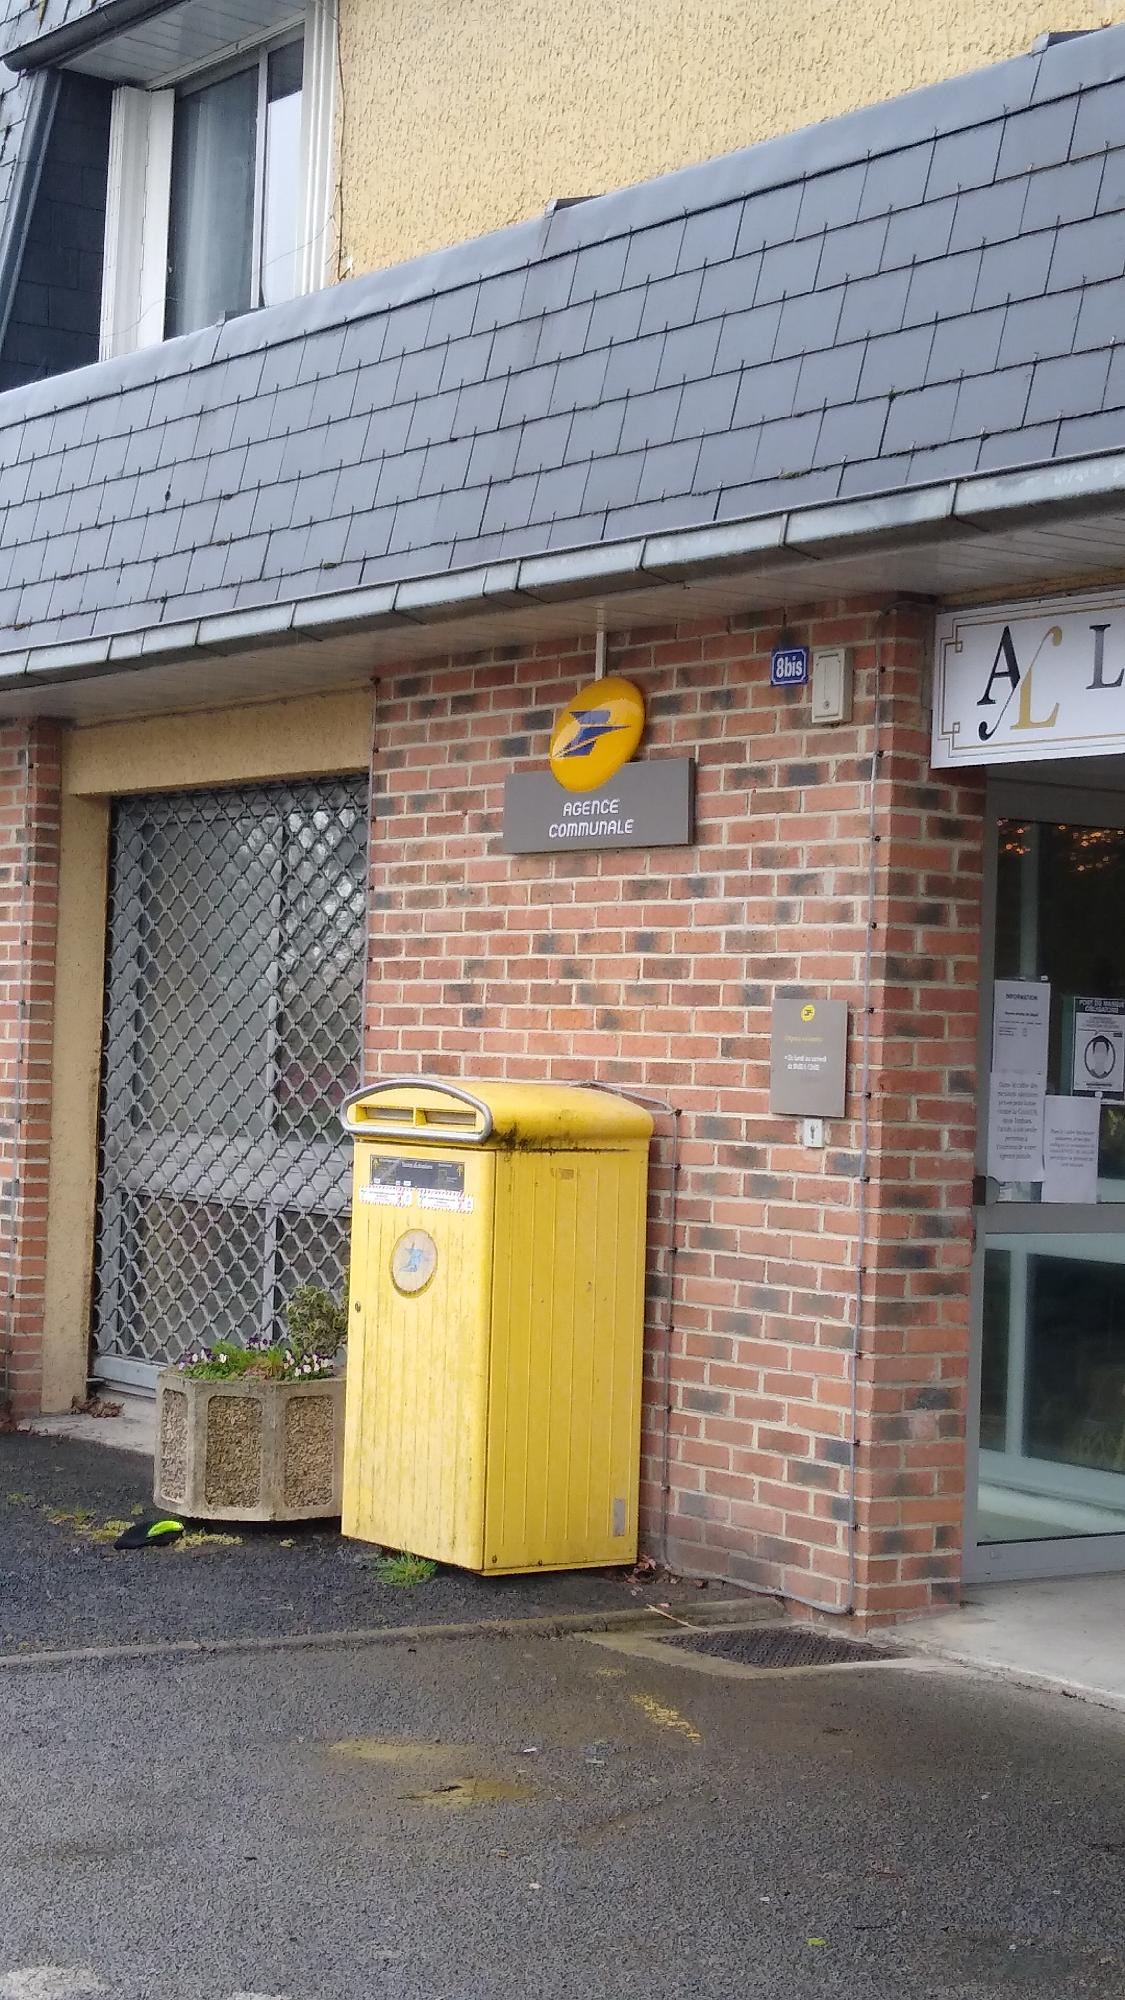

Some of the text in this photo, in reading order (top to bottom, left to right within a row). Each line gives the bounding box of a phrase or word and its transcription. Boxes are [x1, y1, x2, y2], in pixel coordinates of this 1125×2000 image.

[775, 656, 804, 680] 8bis
[562, 798, 620, 817] AGENCE
[548, 818, 635, 838] COMMUNALE
